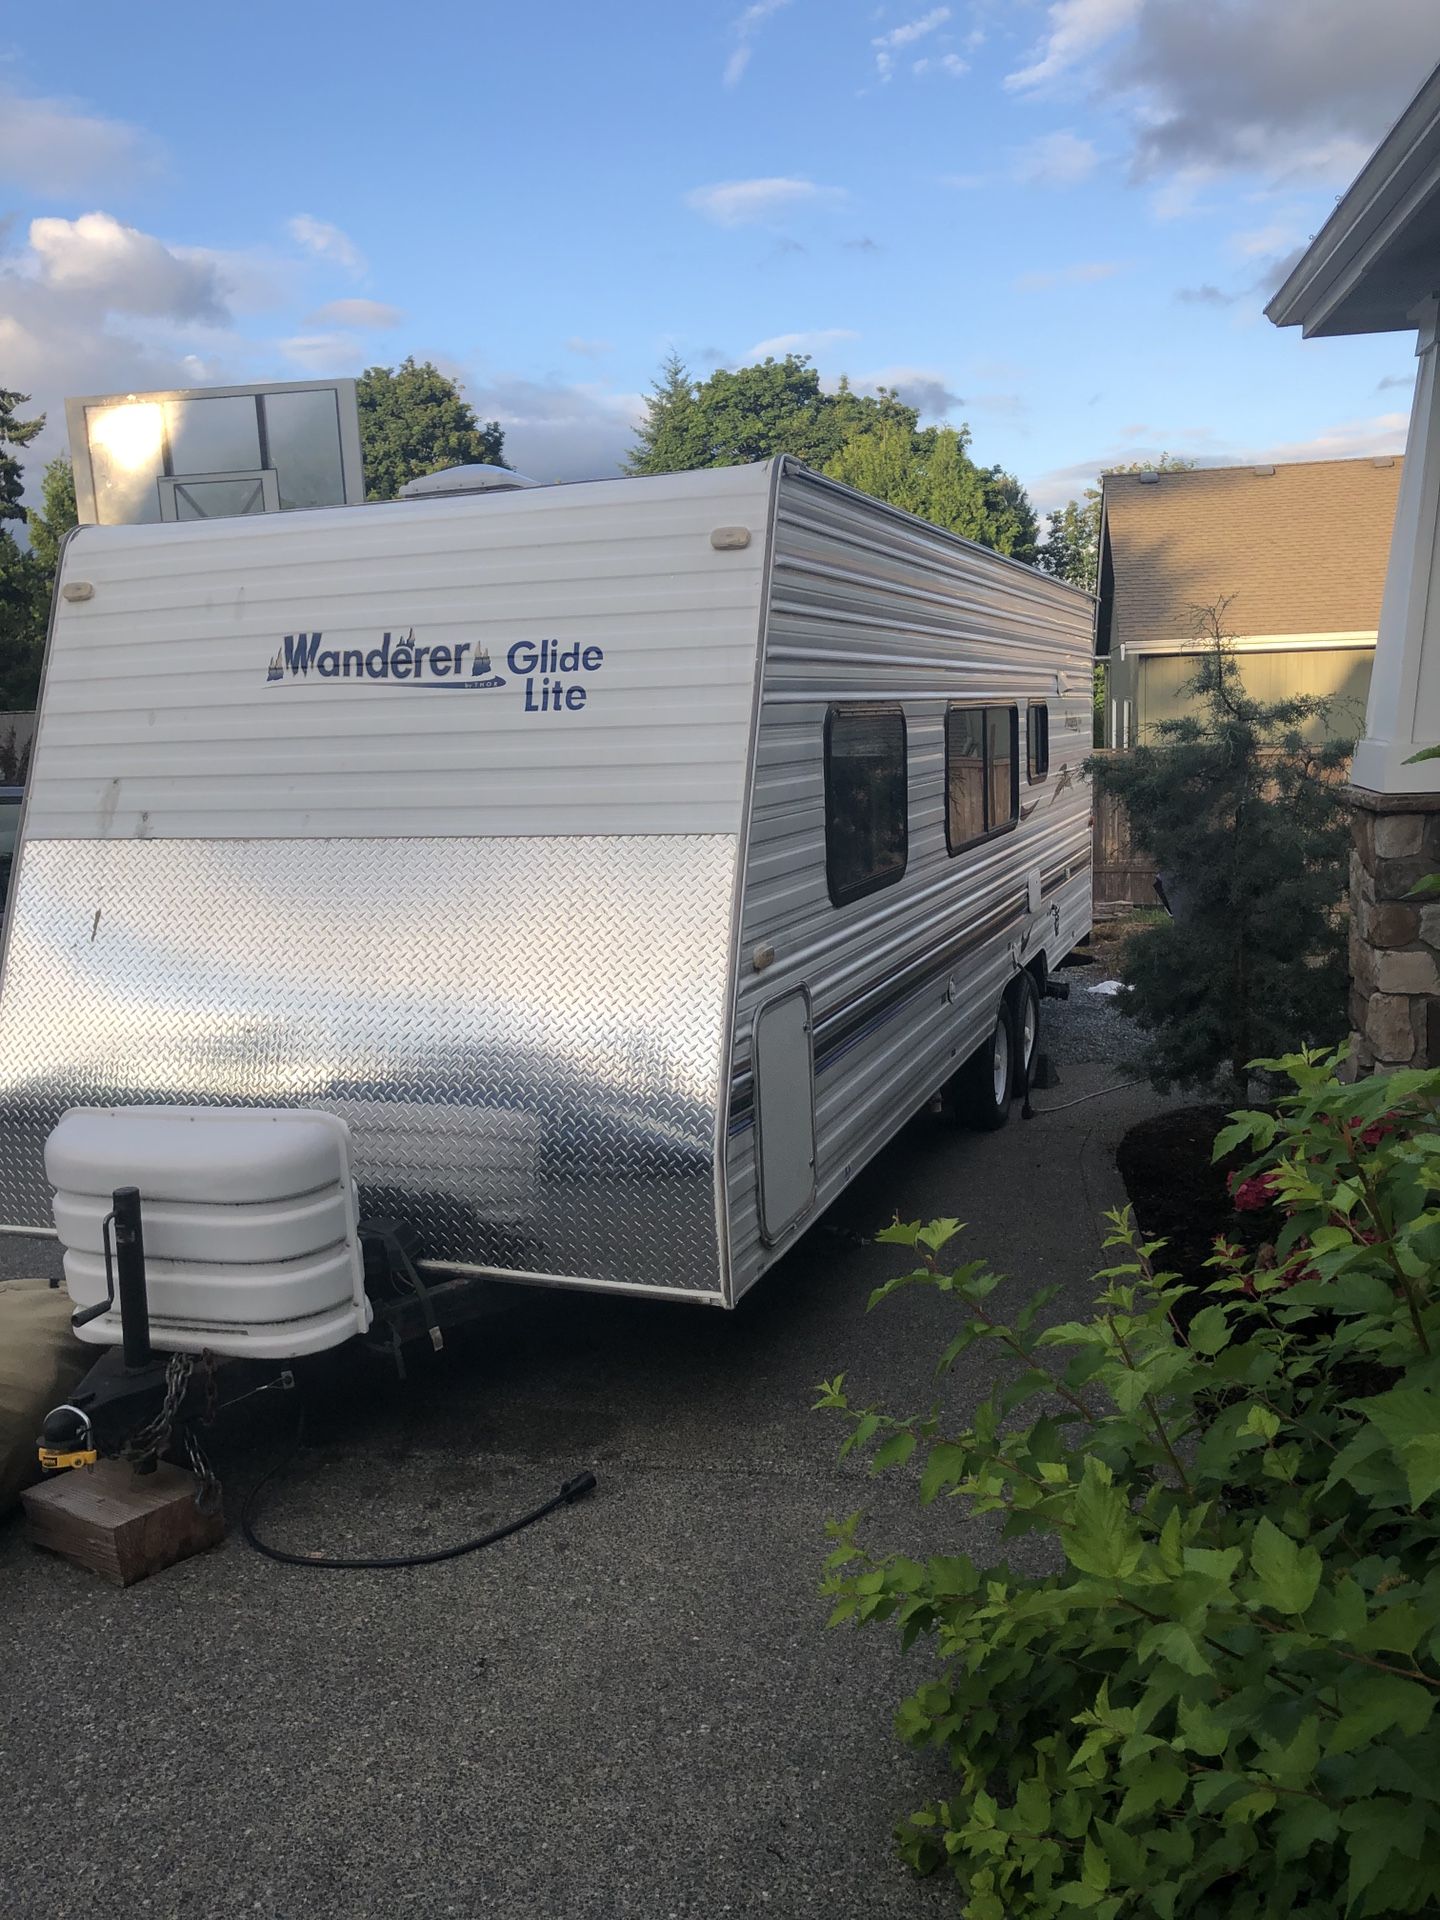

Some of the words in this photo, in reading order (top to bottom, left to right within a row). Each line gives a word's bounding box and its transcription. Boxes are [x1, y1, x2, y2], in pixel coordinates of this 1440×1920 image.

[284, 632, 470, 678] Wanderer
[507, 639, 603, 674] Glide
[525, 677, 587, 712] Lite
